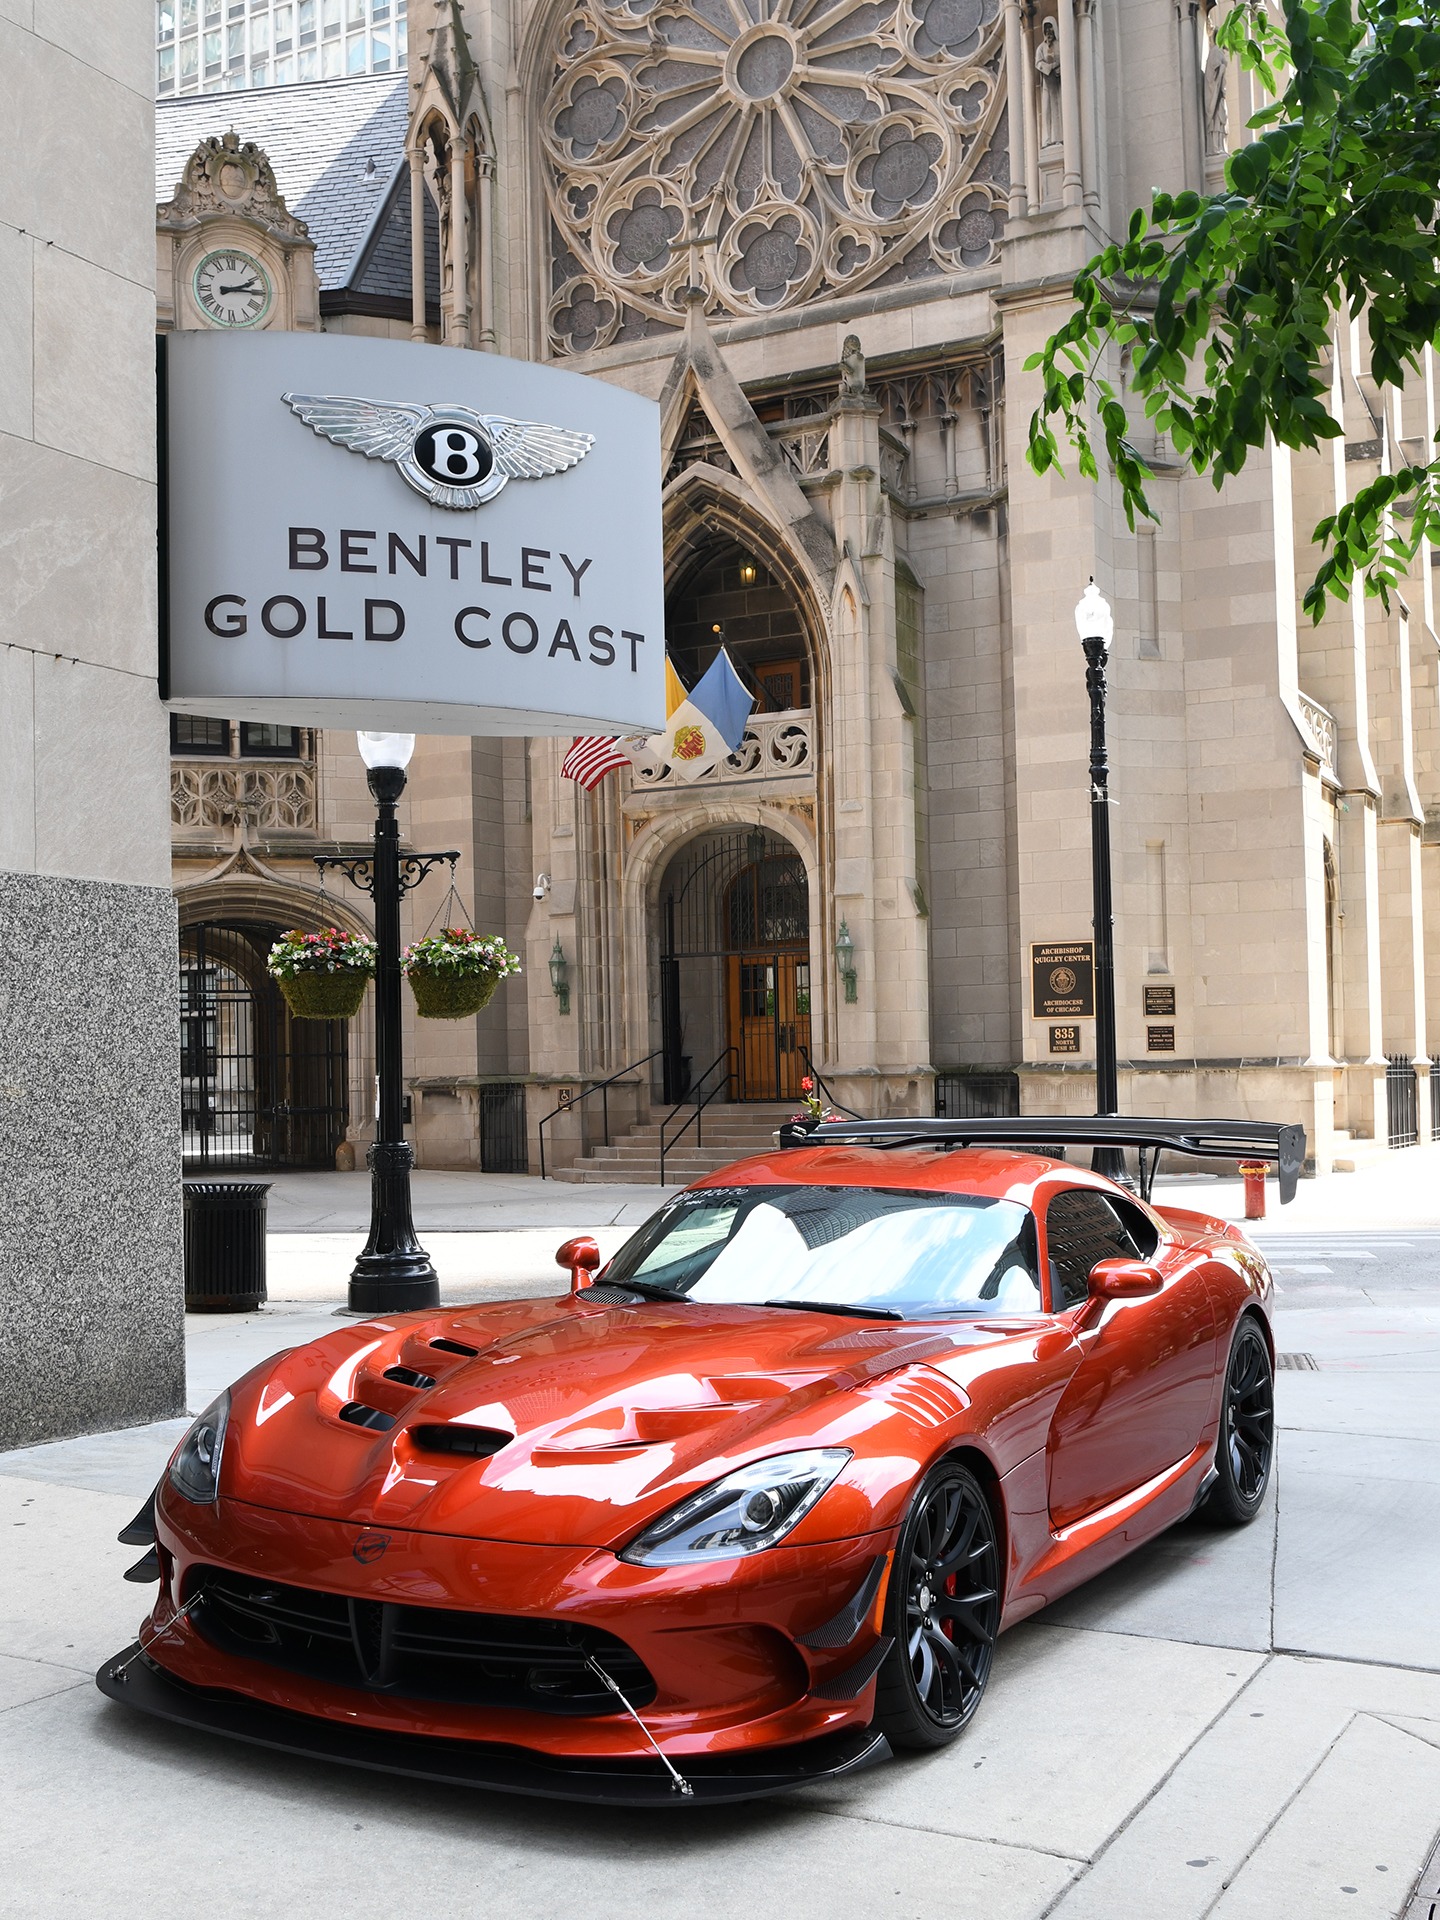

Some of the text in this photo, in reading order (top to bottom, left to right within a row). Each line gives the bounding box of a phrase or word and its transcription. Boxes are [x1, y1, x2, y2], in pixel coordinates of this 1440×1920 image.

[431, 429, 480, 480] B
[288, 527, 593, 597] BENTLEY
[204, 594, 645, 672] GOLD COAST
[1034, 956, 1063, 964] QUIGLEY
[1041, 947, 1084, 955] ARCHBISHOP
[1054, 1027, 1075, 1039] 835
